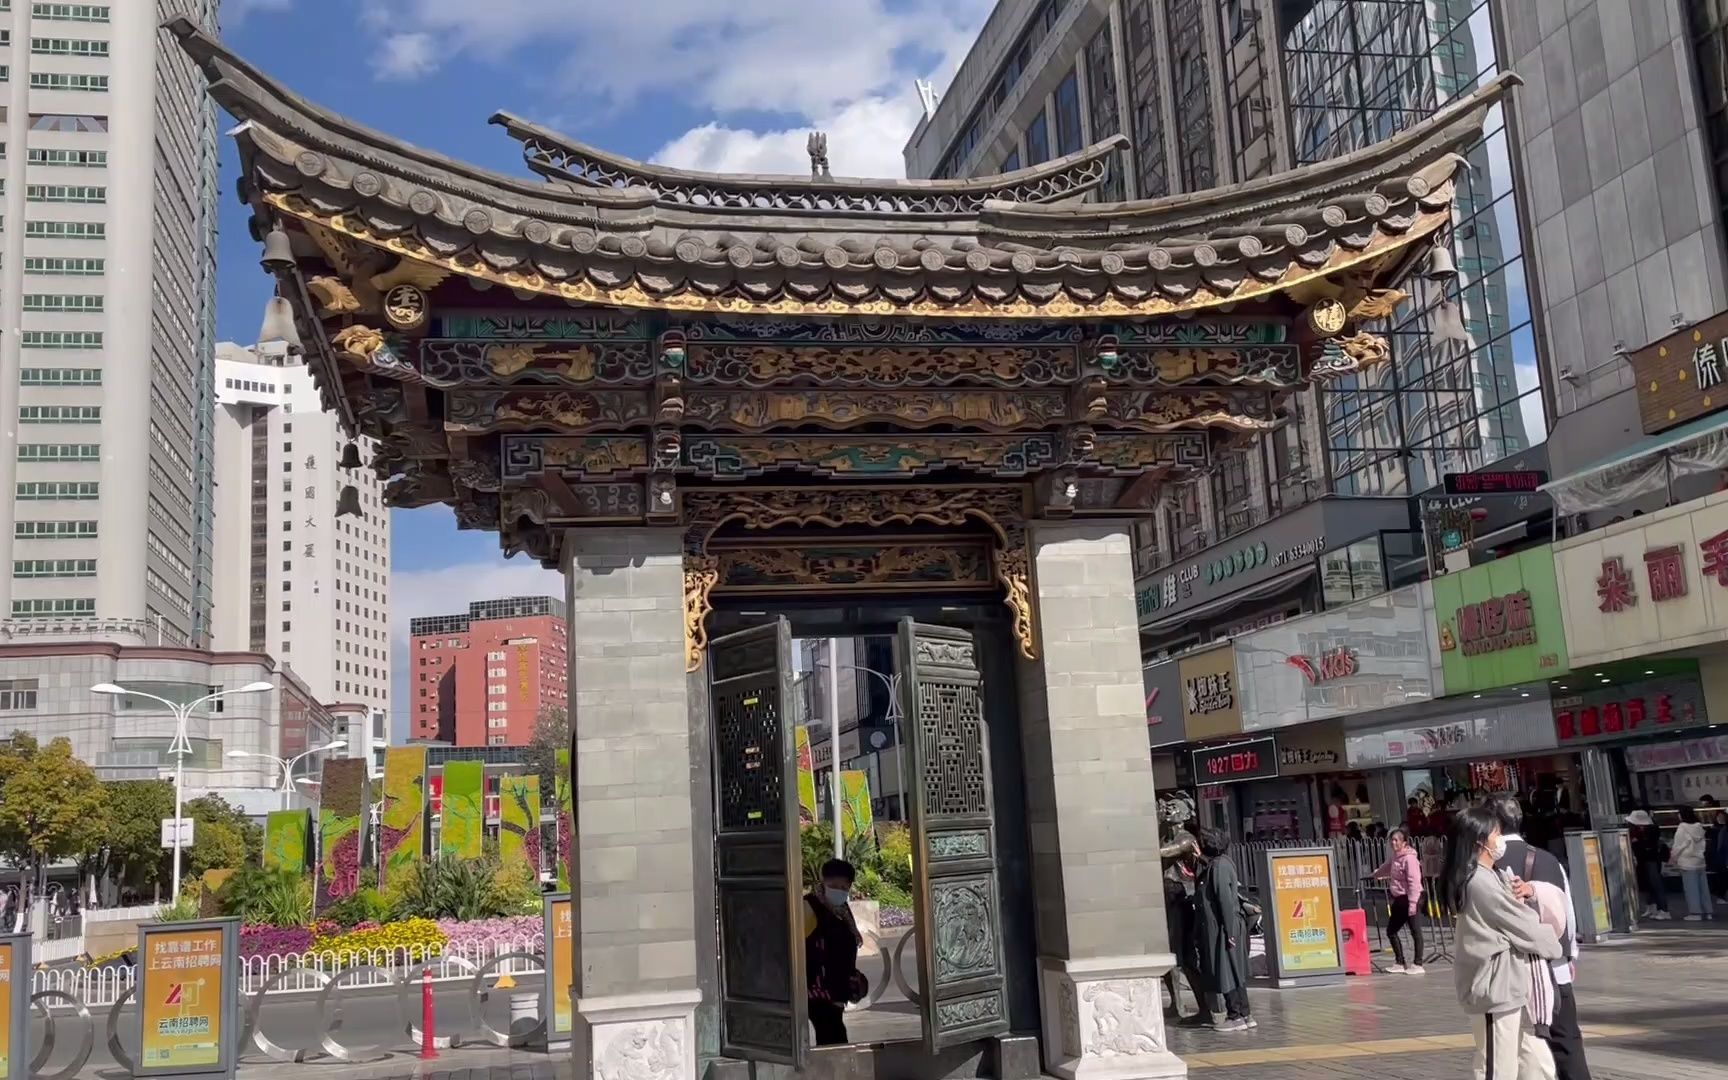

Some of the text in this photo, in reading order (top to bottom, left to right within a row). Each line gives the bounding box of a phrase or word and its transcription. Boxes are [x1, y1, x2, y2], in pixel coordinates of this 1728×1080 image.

[1693, 338, 1728, 390] 傣
[1319, 646, 1358, 680] kids
[154, 938, 217, 955] 找靠谱工作
[148, 953, 222, 971] 上云南招聘网
[159, 1015, 209, 1029] 云南招聘网
